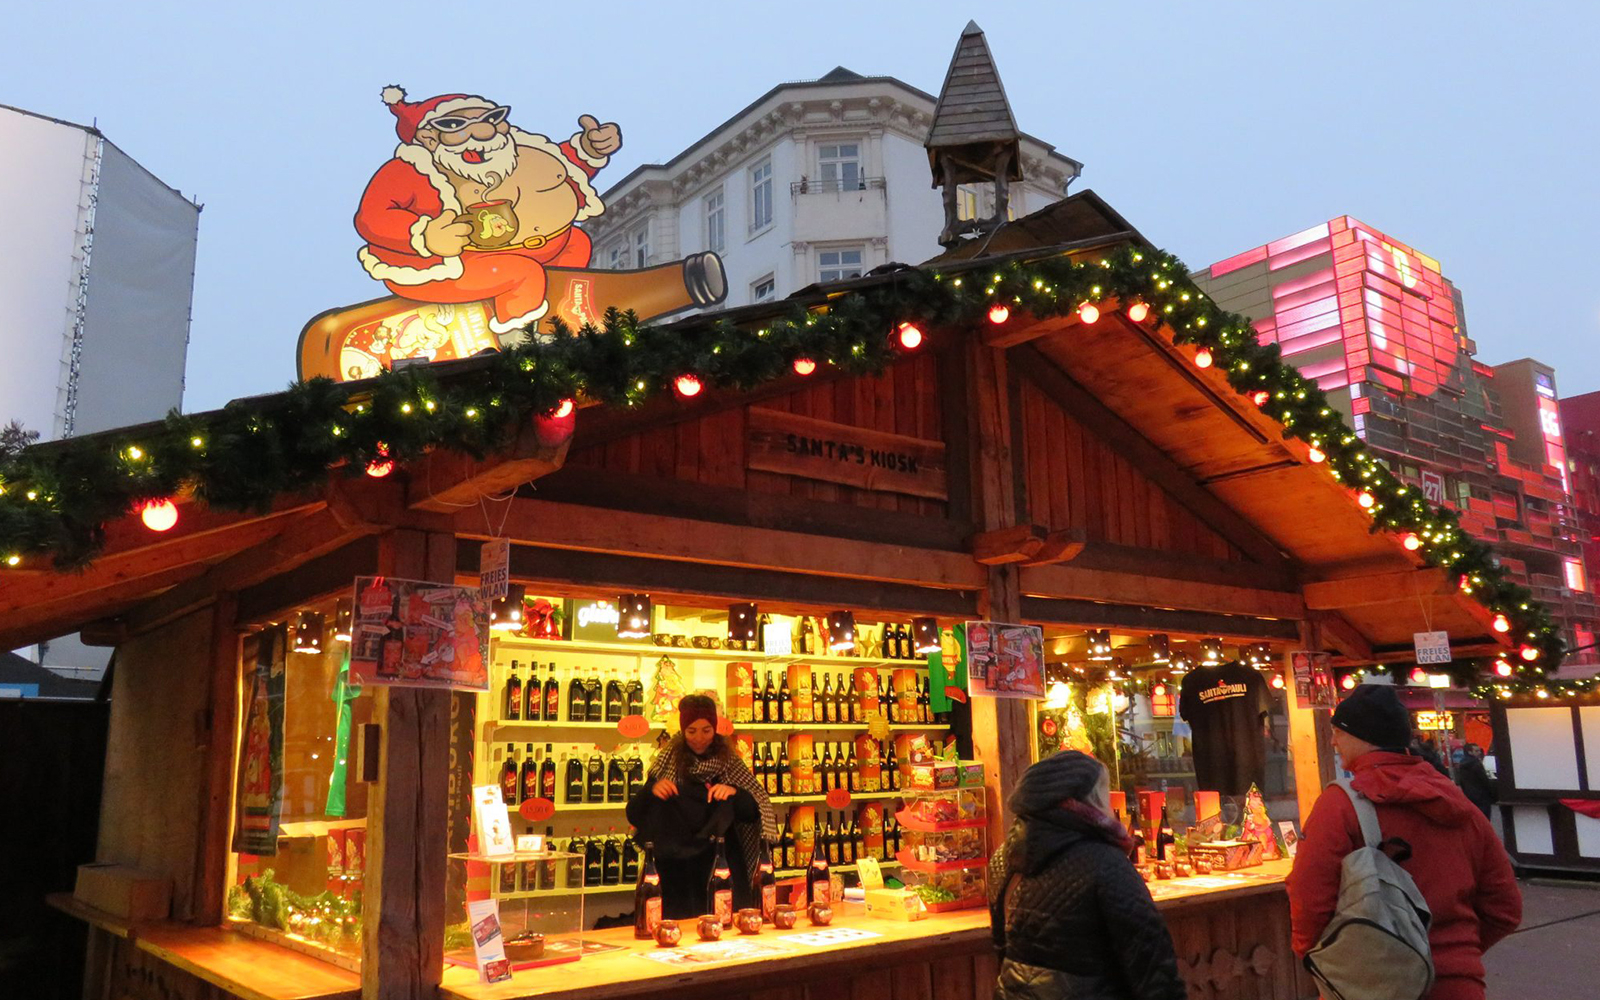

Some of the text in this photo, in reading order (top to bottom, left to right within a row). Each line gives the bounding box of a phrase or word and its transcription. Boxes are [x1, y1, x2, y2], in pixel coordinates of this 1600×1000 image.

[786, 433, 918, 474] SANTA'S KIOSK
[1425, 480, 1439, 502] 27
[480, 567, 507, 586] FREIES
[480, 582, 507, 600] WLAN
[1417, 647, 1449, 656] FREIES
[1419, 654, 1450, 663] WLAN
[1199, 687, 1222, 701] SANTA
[1227, 683, 1247, 693] PAULI
